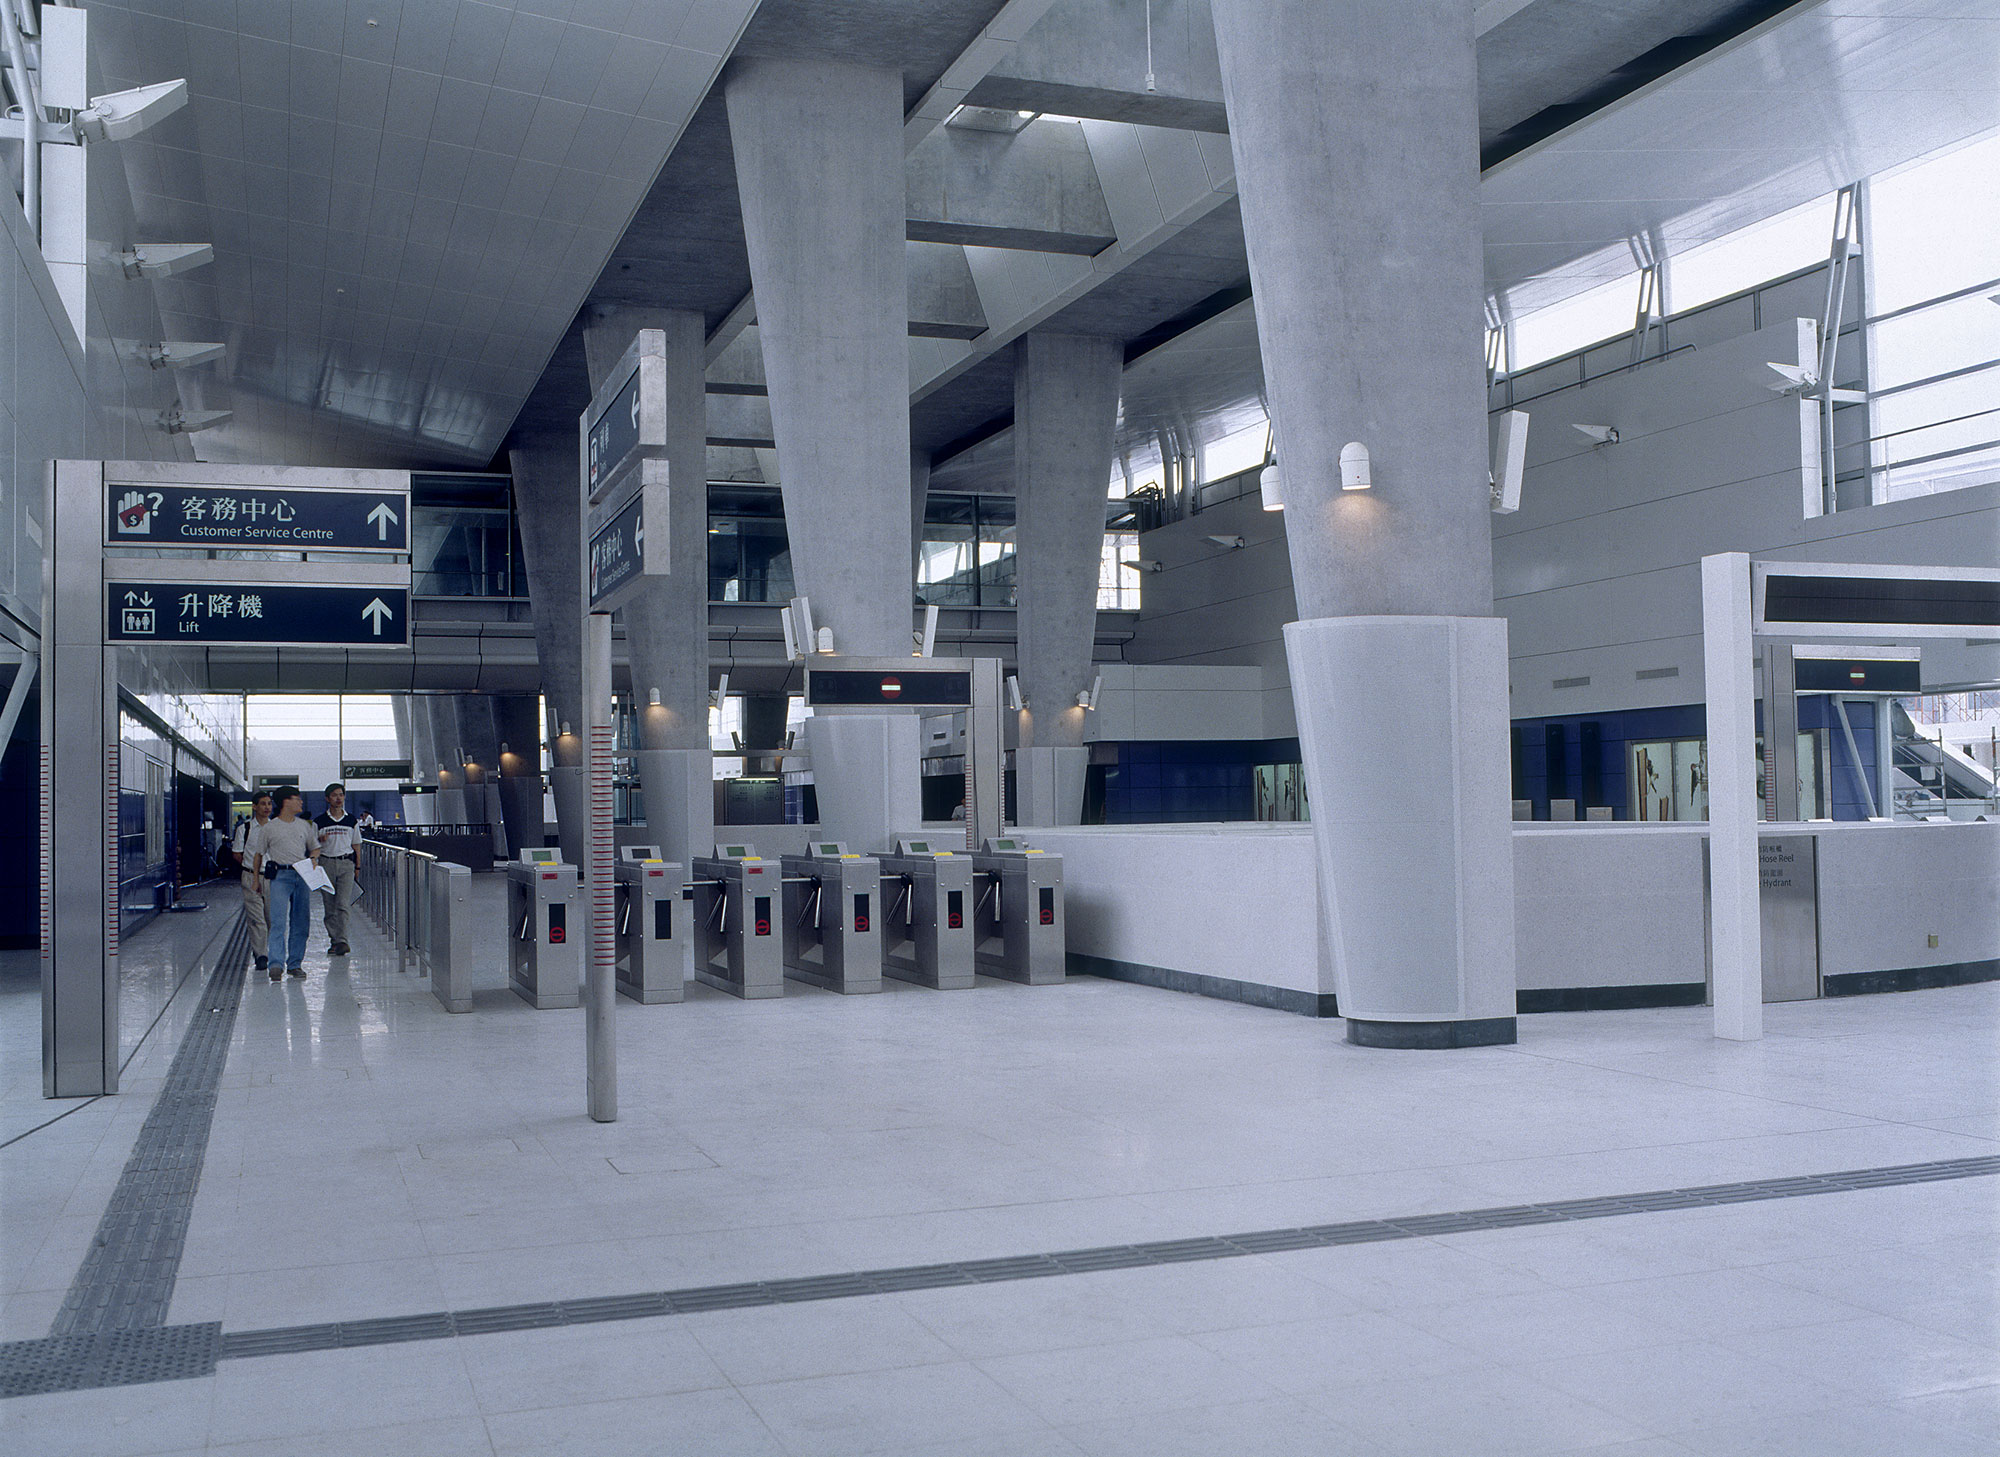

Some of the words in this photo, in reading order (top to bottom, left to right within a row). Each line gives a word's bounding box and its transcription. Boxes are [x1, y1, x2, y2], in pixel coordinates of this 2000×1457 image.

[181, 496, 296, 522] 客務中心
[180, 524, 242, 537] Customer
[245, 526, 290, 538] Service
[292, 527, 334, 540] Centre
[178, 592, 263, 618] 升降機
[179, 620, 200, 633] Lift
[1759, 855, 1777, 863] Hose
[1779, 854, 1794, 862] Reel
[1763, 879, 1792, 889] Hydrant
